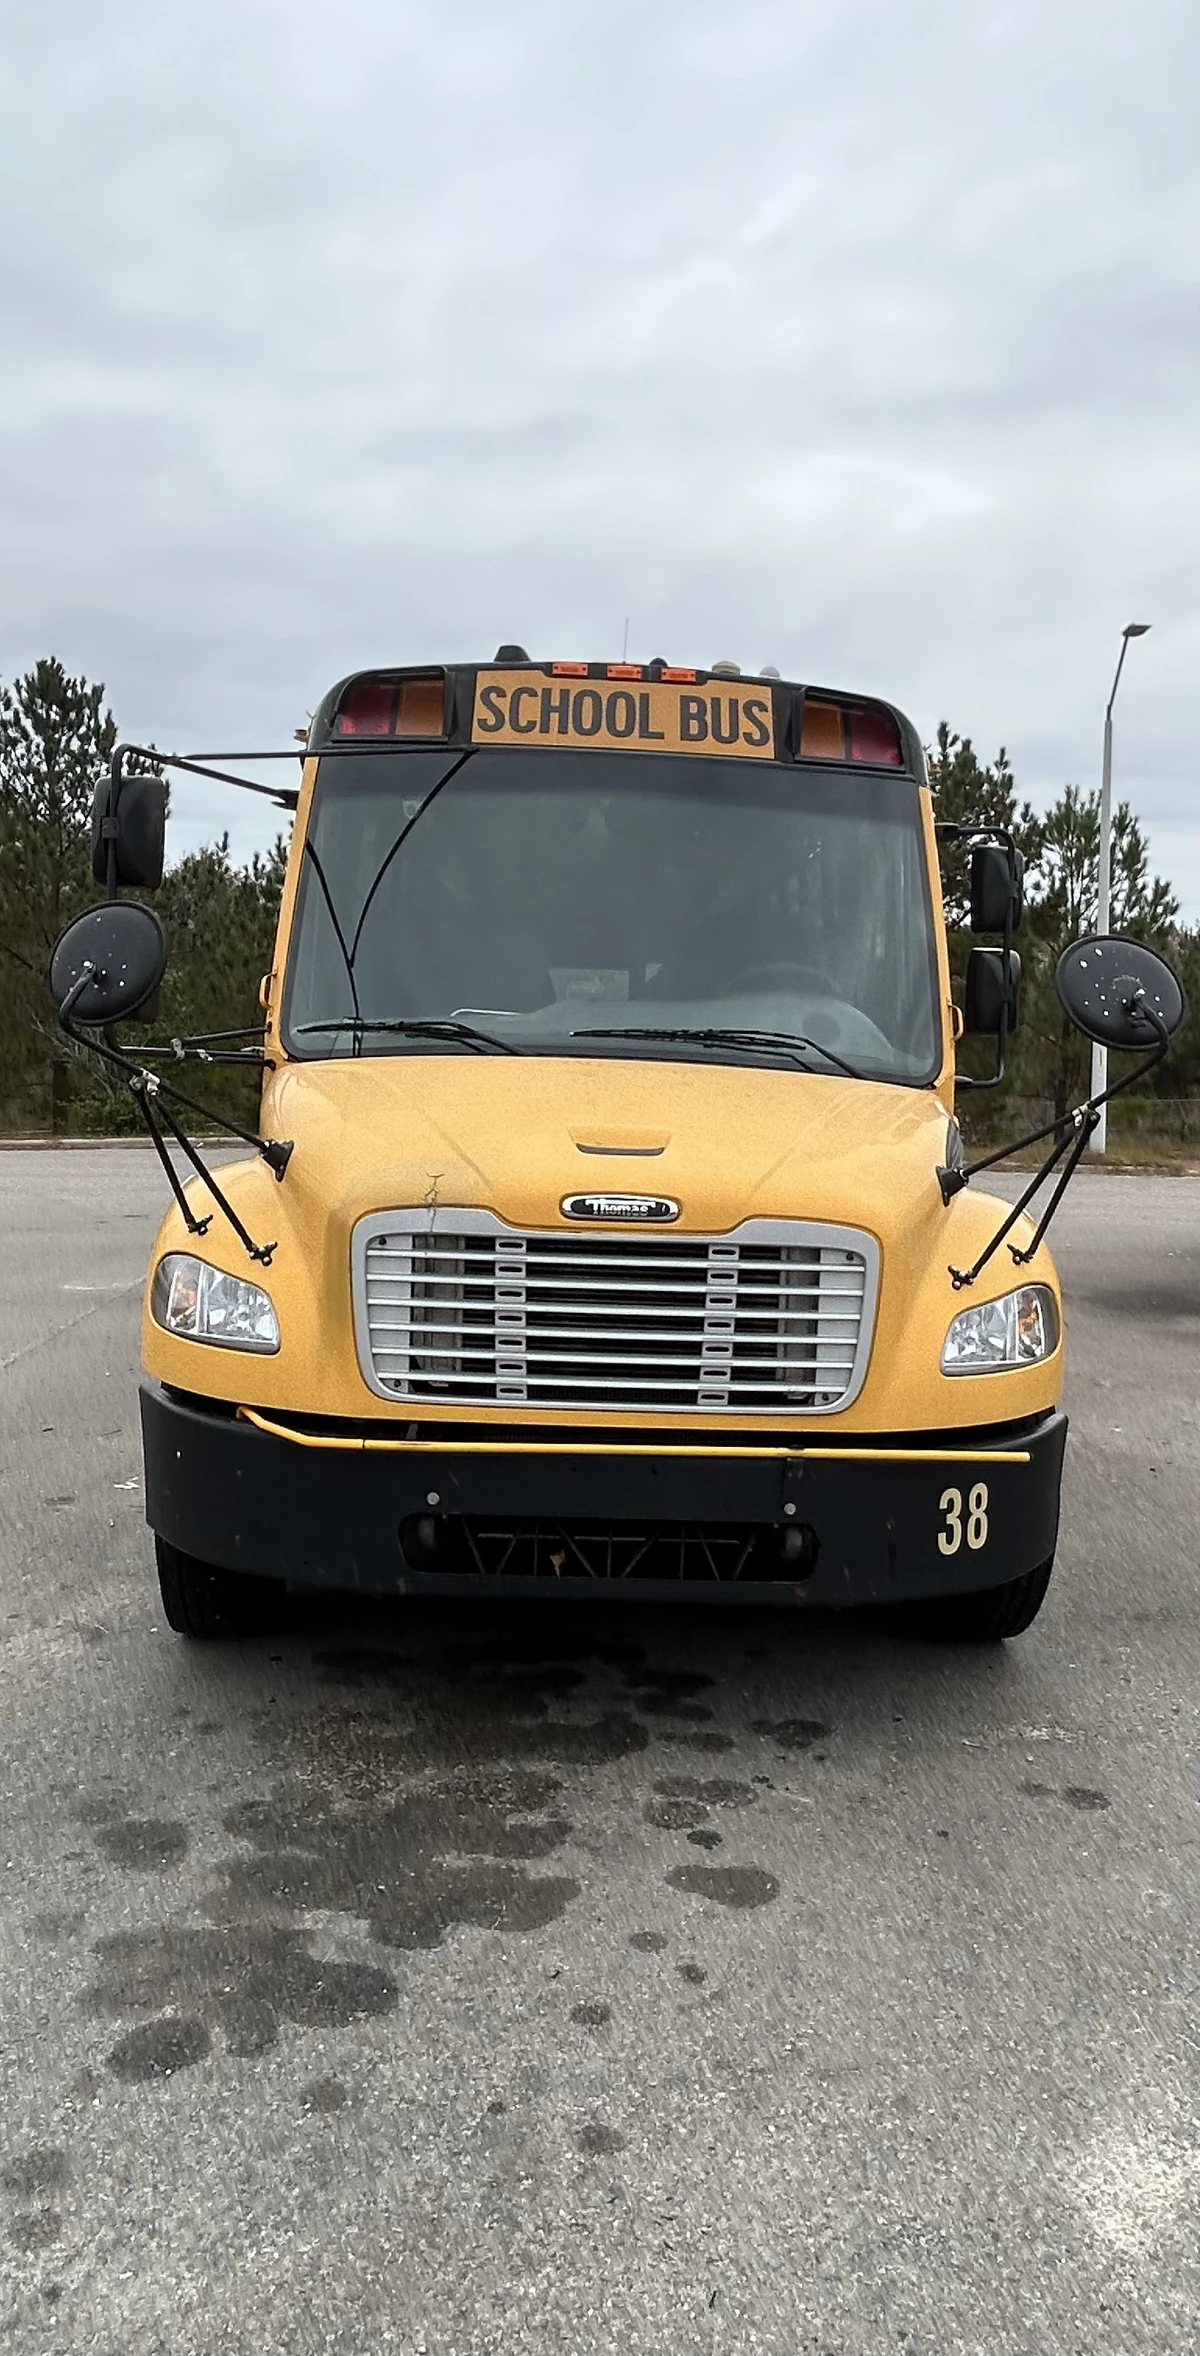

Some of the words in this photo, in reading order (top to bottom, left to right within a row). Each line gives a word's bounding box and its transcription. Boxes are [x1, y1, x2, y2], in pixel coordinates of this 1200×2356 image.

[477, 686, 665, 740] SCHOOL
[680, 695, 770, 747] BUS
[585, 1199, 656, 1217] Thomas
[938, 1482, 988, 1555] 38
